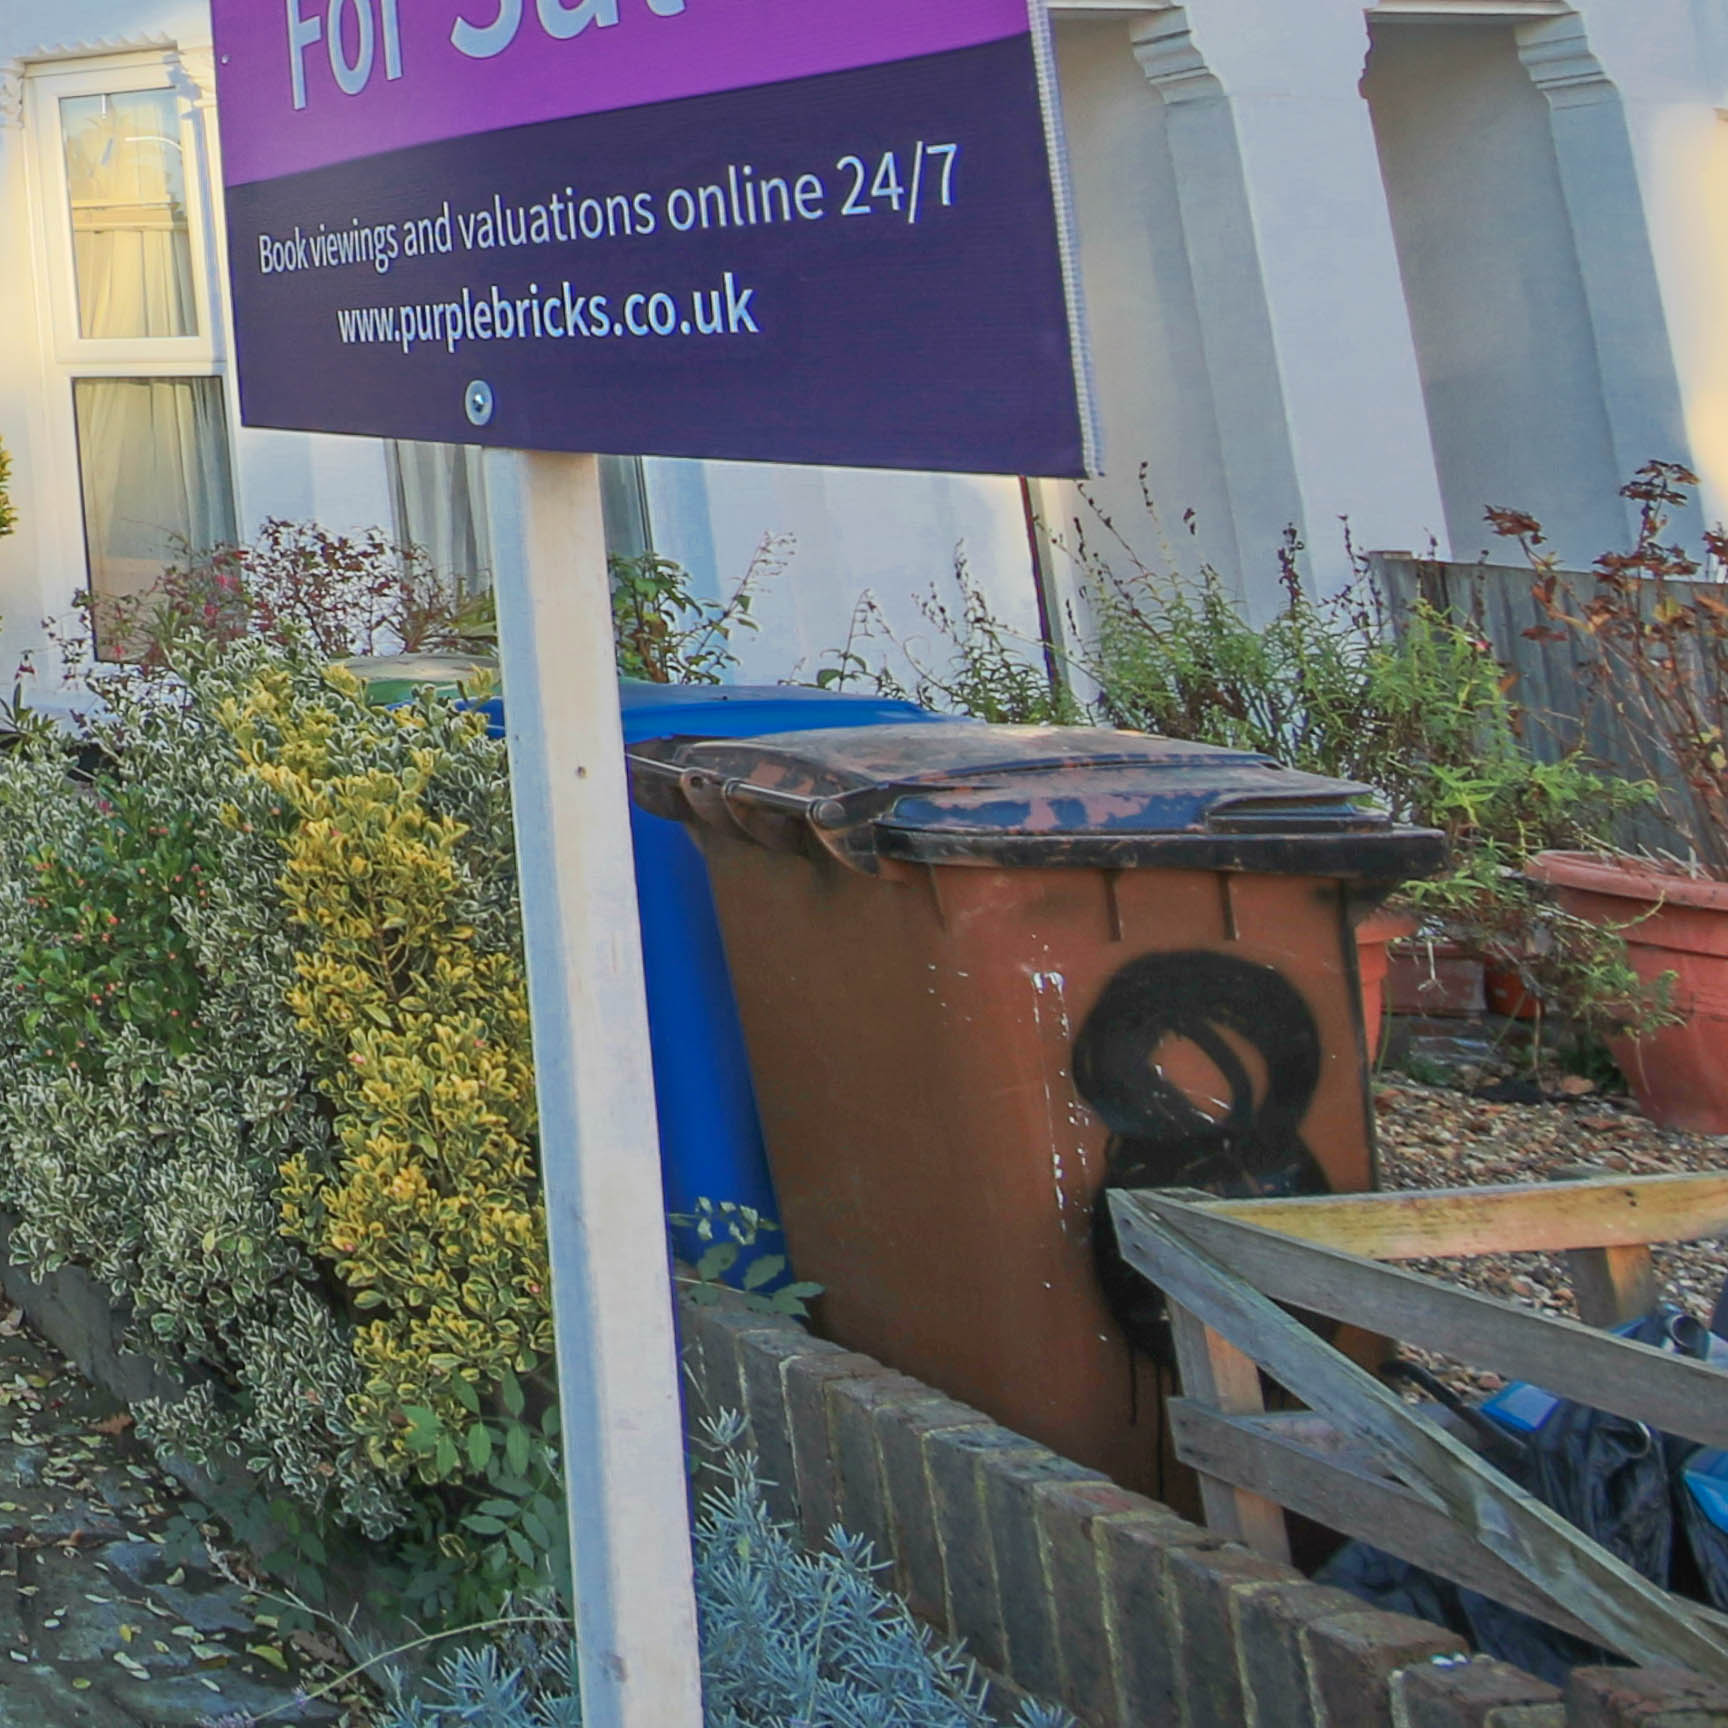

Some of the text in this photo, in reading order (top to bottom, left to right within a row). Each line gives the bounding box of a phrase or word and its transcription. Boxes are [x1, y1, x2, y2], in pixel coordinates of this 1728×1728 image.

[259, 140, 959, 275] Book viewings and valuations online 24/7
[337, 271, 760, 354] www.purplebricks.co.uk
